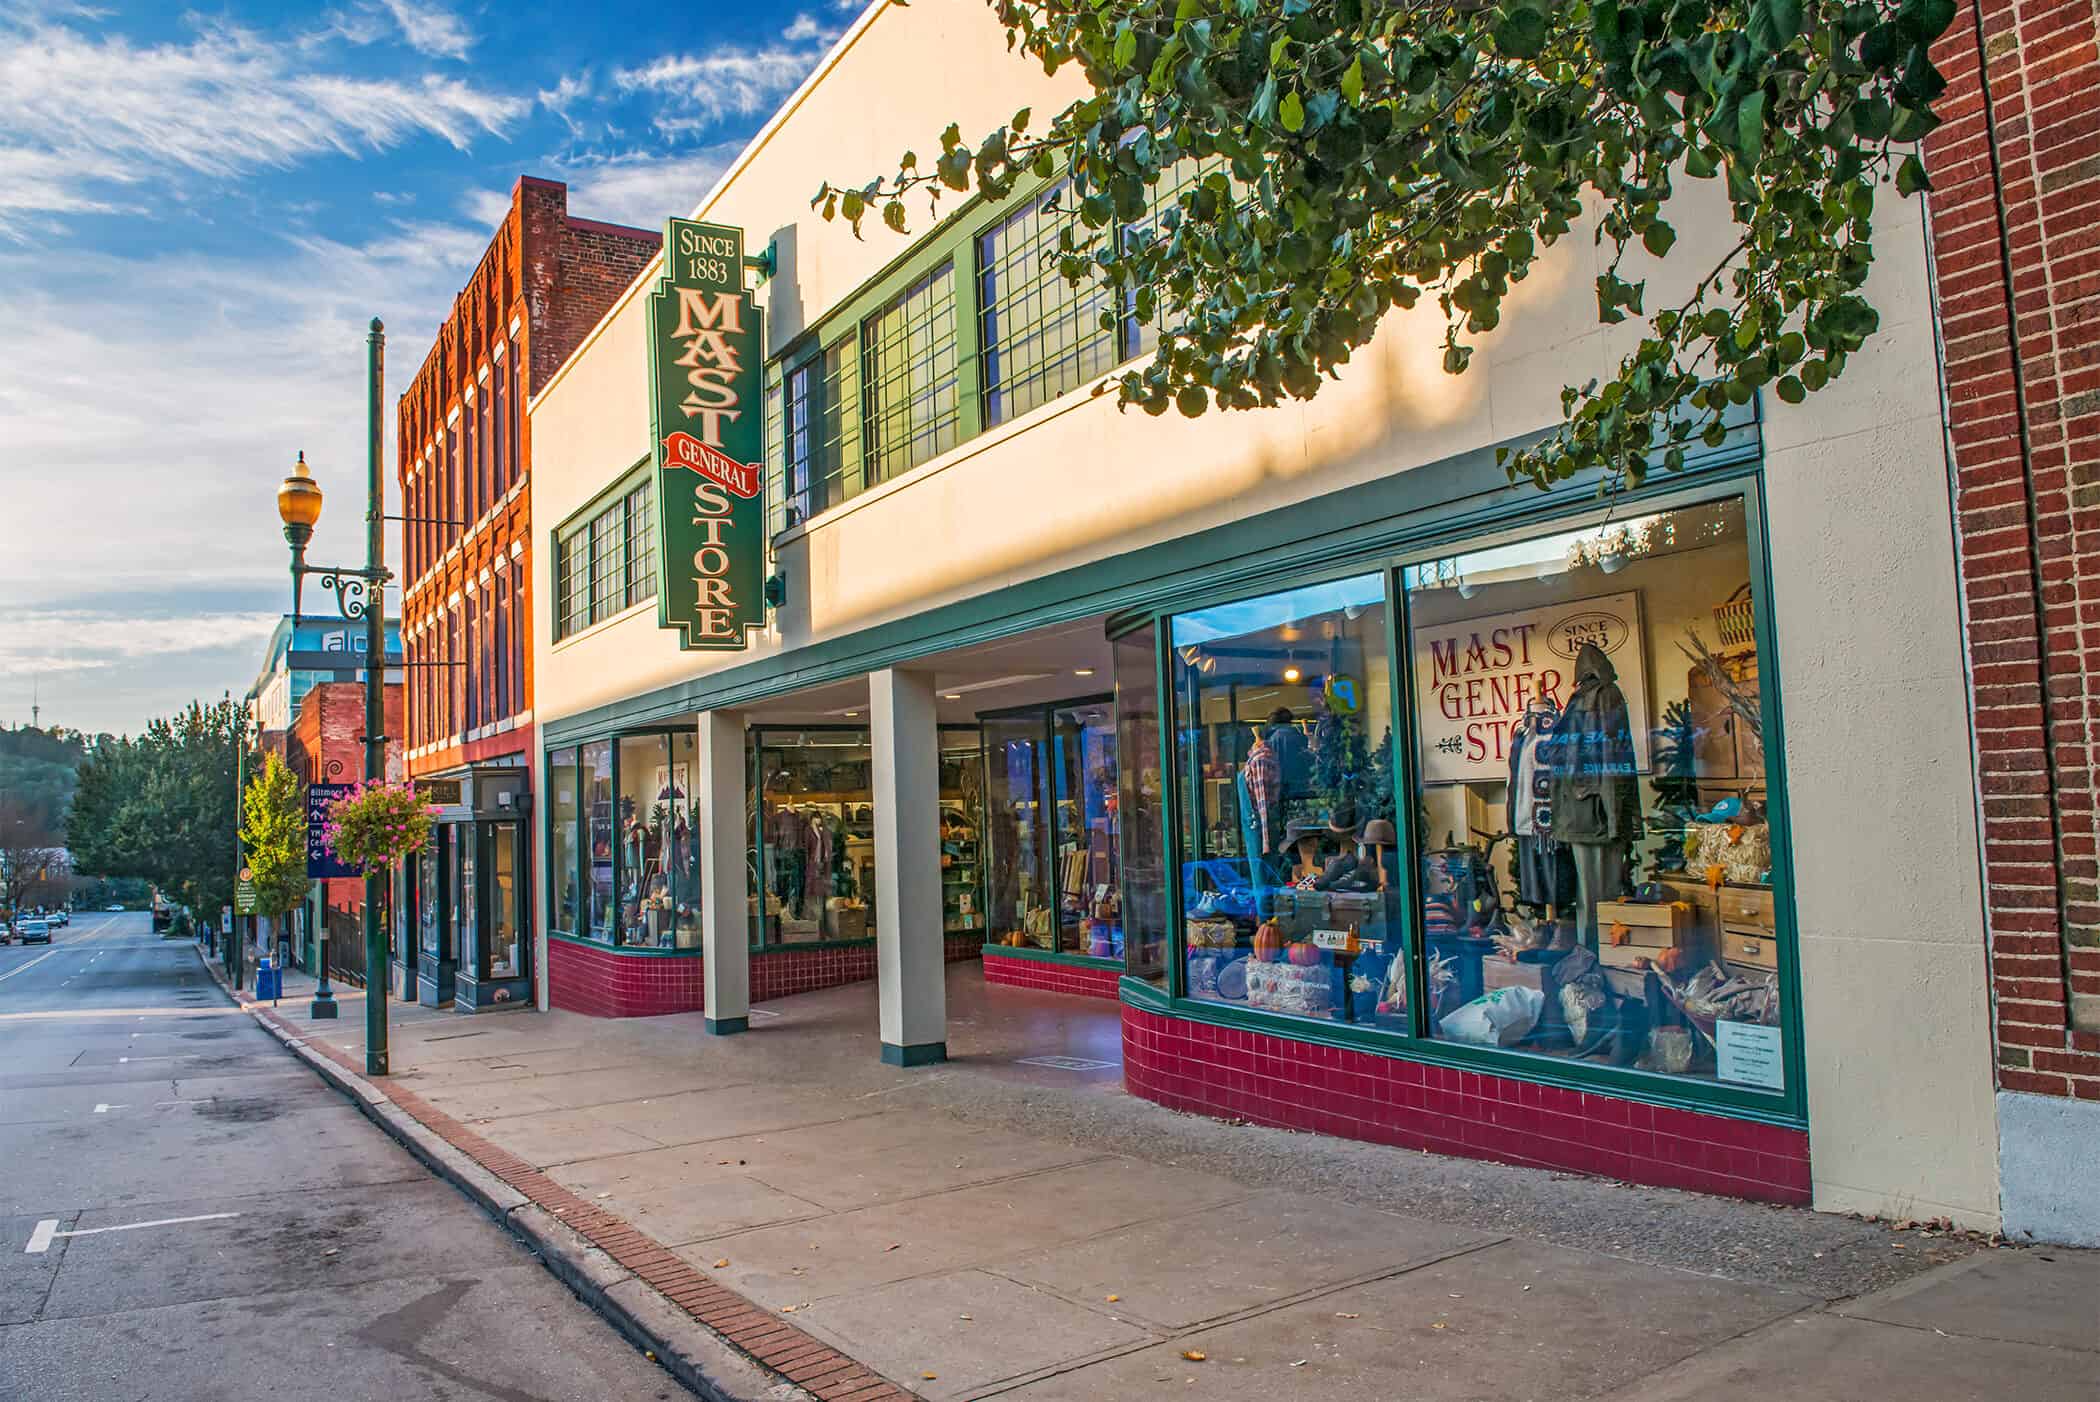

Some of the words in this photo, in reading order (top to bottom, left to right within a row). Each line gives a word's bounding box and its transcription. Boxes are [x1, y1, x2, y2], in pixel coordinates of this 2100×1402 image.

[680, 228, 735, 257] SINCE
[688, 257, 728, 284] 1883
[671, 287, 745, 448] MAST
[678, 438, 751, 494] GENERAL
[691, 482, 737, 638] STORE
[1564, 620, 1608, 637] SINCE
[1567, 632, 1609, 653] 1883
[1429, 623, 1538, 691] MAST
[1439, 669, 1577, 720] GENER
